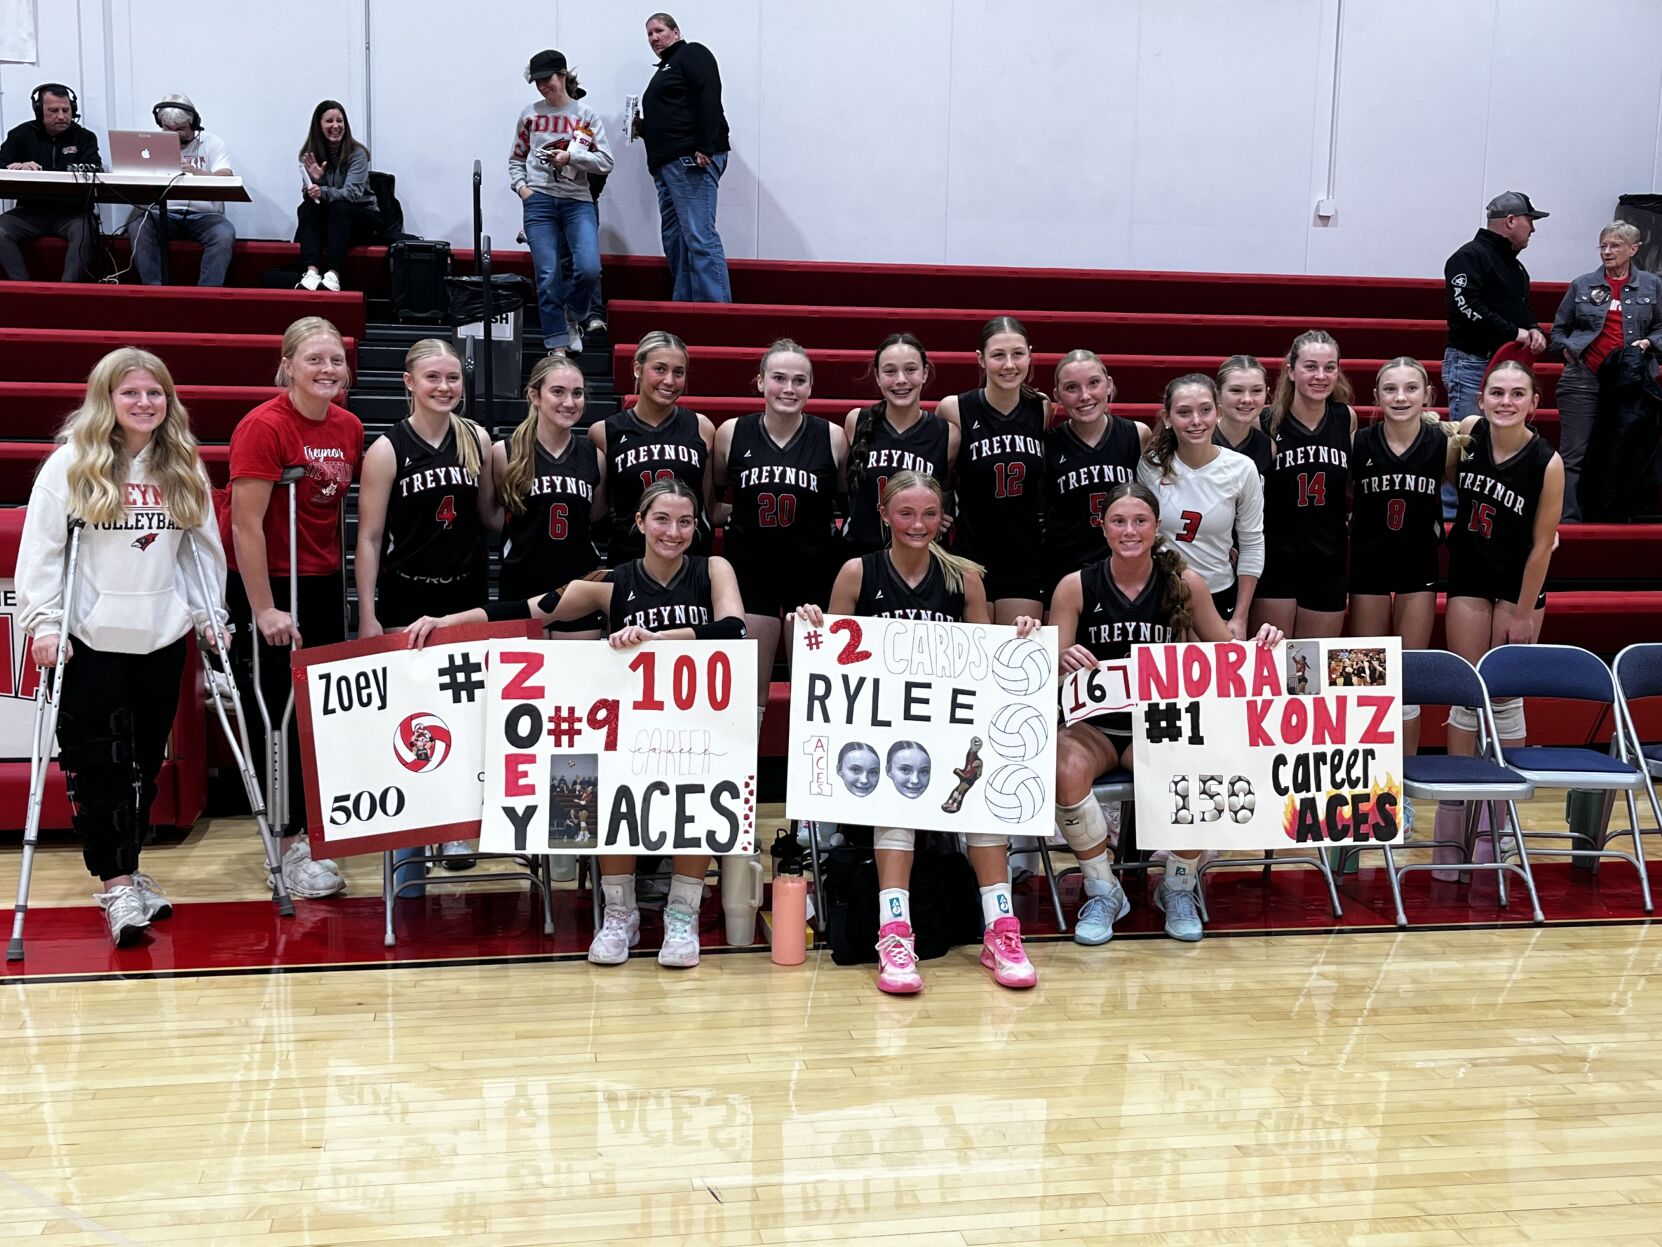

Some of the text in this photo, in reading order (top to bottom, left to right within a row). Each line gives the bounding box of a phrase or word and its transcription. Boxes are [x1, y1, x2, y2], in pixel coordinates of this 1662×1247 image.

[1453, 287, 1483, 321] ARIAT
[303, 445, 346, 463] Treynor
[614, 444, 700, 473] TREYNOR
[867, 449, 934, 477] REYNOR
[1275, 446, 1348, 471] TREYNOR
[740, 466, 818, 493] TREYNOR
[994, 461, 1026, 499] 12
[1057, 464, 1134, 495] TREYNOR
[1297, 471, 1326, 507] 14
[1361, 474, 1436, 495] TREYNOR
[1459, 472, 1525, 516] TREYNOR
[435, 495, 457, 530] 4
[549, 502, 569, 540] 6
[757, 493, 797, 528] 20
[1175, 510, 1203, 543] 3
[1386, 498, 1406, 531] 8
[1468, 500, 1496, 538] 15
[882, 620, 989, 681] CARDS
[1088, 621, 1172, 644] TREYNOR
[628, 651, 732, 712] 100
[1068, 664, 1132, 715] 167
[1137, 642, 1283, 701] NORA
[318, 666, 388, 716] Zoey
[806, 672, 977, 728] RYLEE
[547, 698, 620, 752] #9
[1144, 700, 1205, 745] #1
[1246, 695, 1396, 748] KONZ
[499, 651, 546, 851] ZOEY
[1271, 748, 1377, 797] career
[329, 785, 406, 826] 500
[604, 779, 742, 854] ACES
[1168, 774, 1257, 825] 150
[1295, 791, 1399, 844] ACES
